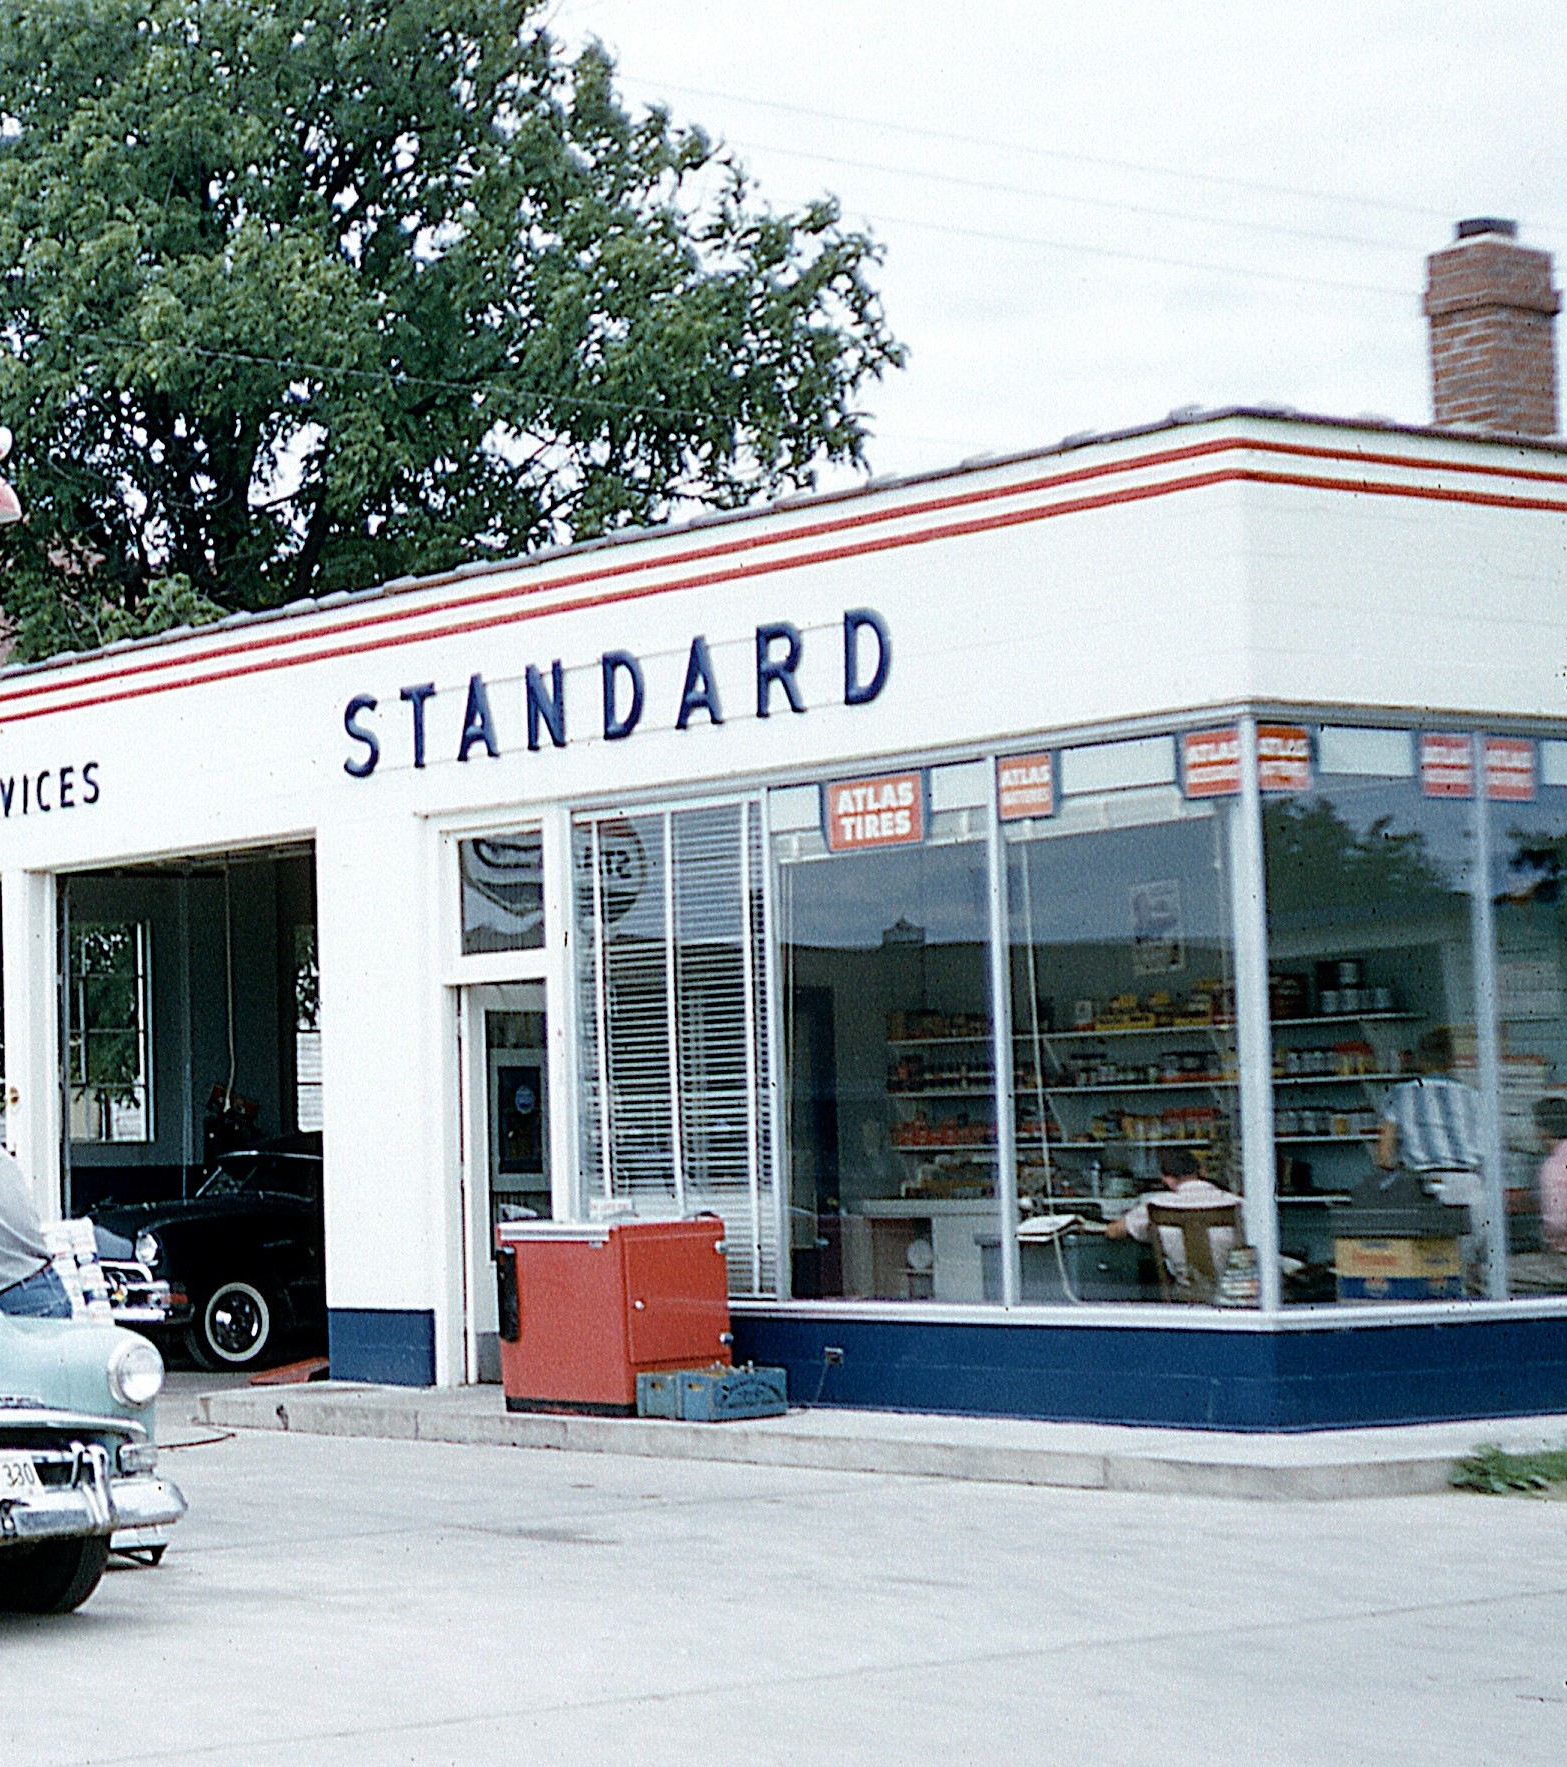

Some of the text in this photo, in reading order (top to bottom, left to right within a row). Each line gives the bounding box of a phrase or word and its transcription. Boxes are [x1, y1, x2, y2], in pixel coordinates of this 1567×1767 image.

[343, 608, 892, 778] STANDARD
[1000, 765, 1050, 787] ATLAS
[838, 781, 915, 814] ATLAS
[840, 810, 912, 841] TIRES
[2, 1462, 35, 1487] 330
